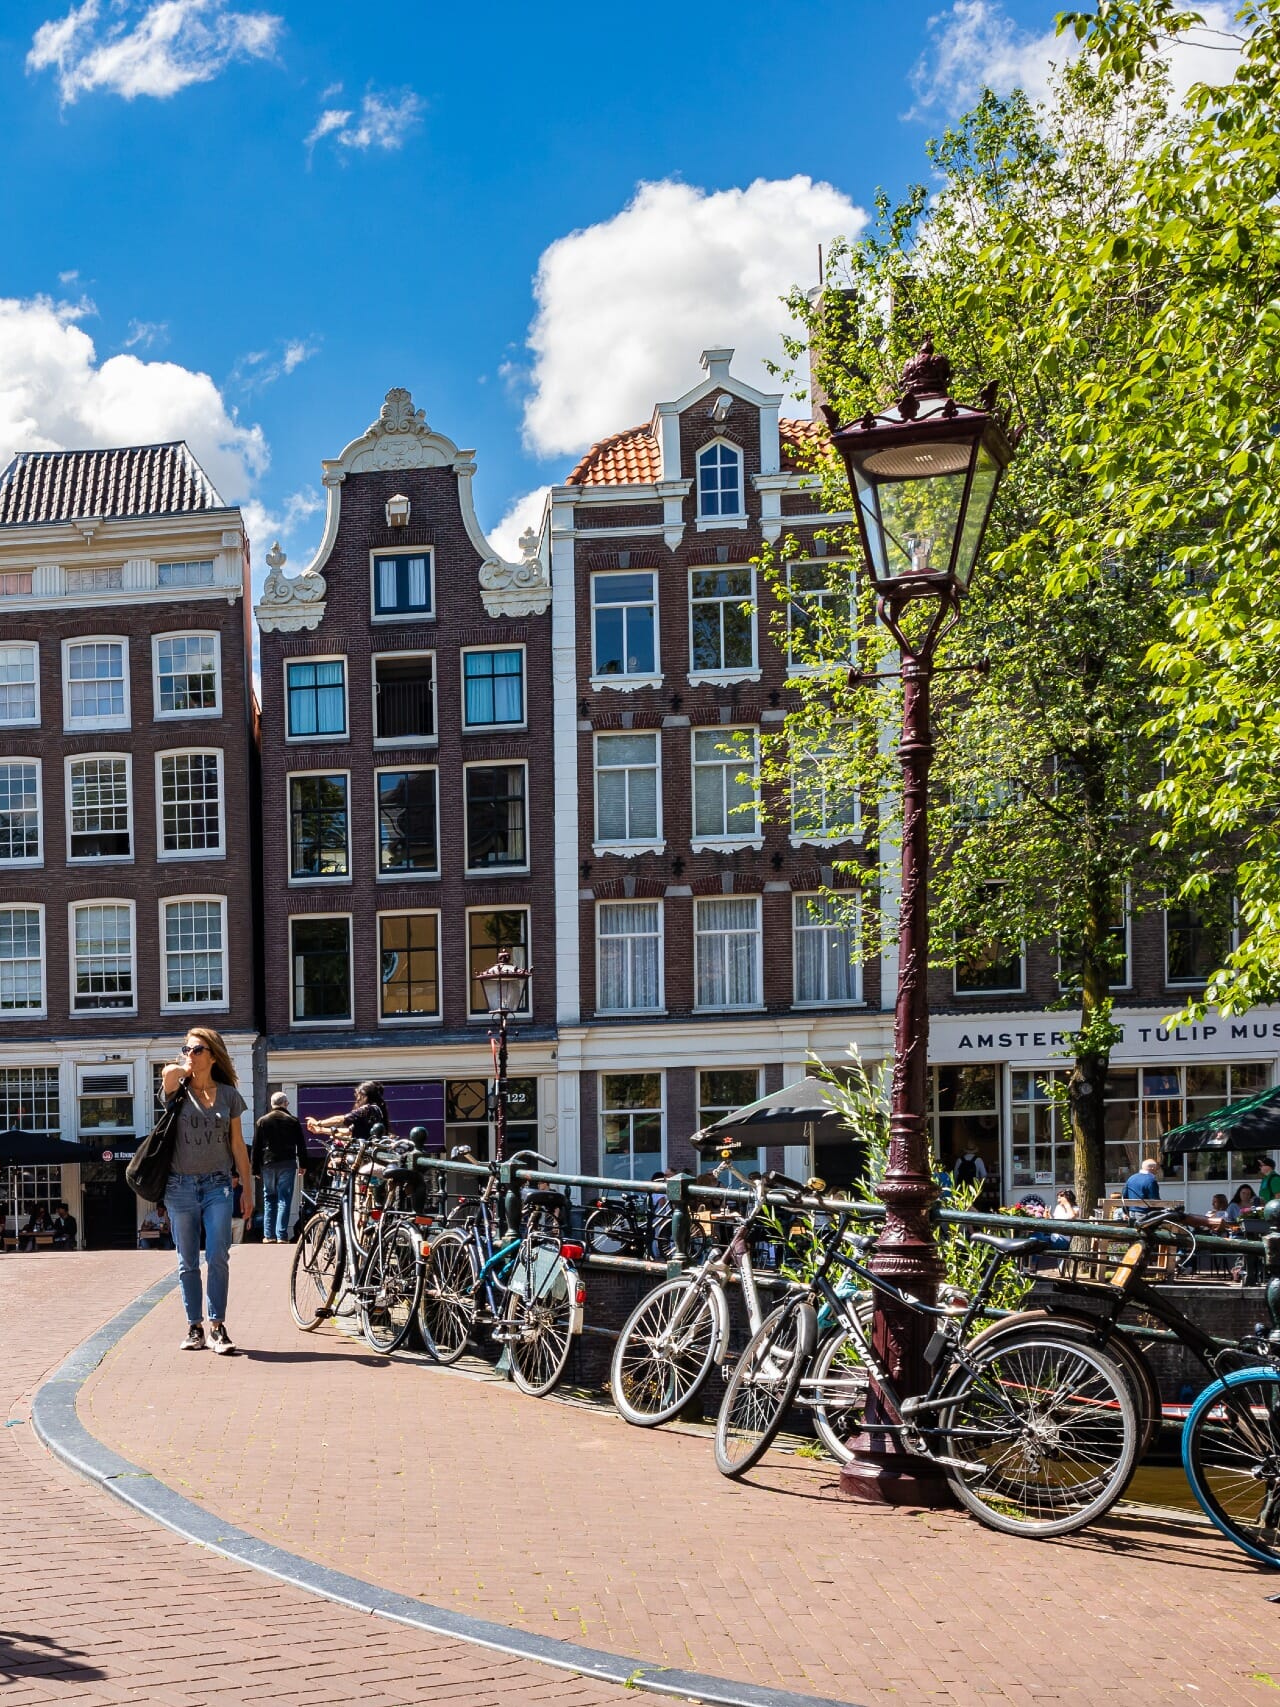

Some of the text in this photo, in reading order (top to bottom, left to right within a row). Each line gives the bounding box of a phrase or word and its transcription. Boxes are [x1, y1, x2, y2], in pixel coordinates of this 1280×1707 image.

[958, 1030, 1124, 1048] AMSTER
[1138, 1026, 1217, 1042] TULIP
[506, 1093, 526, 1103] 122
